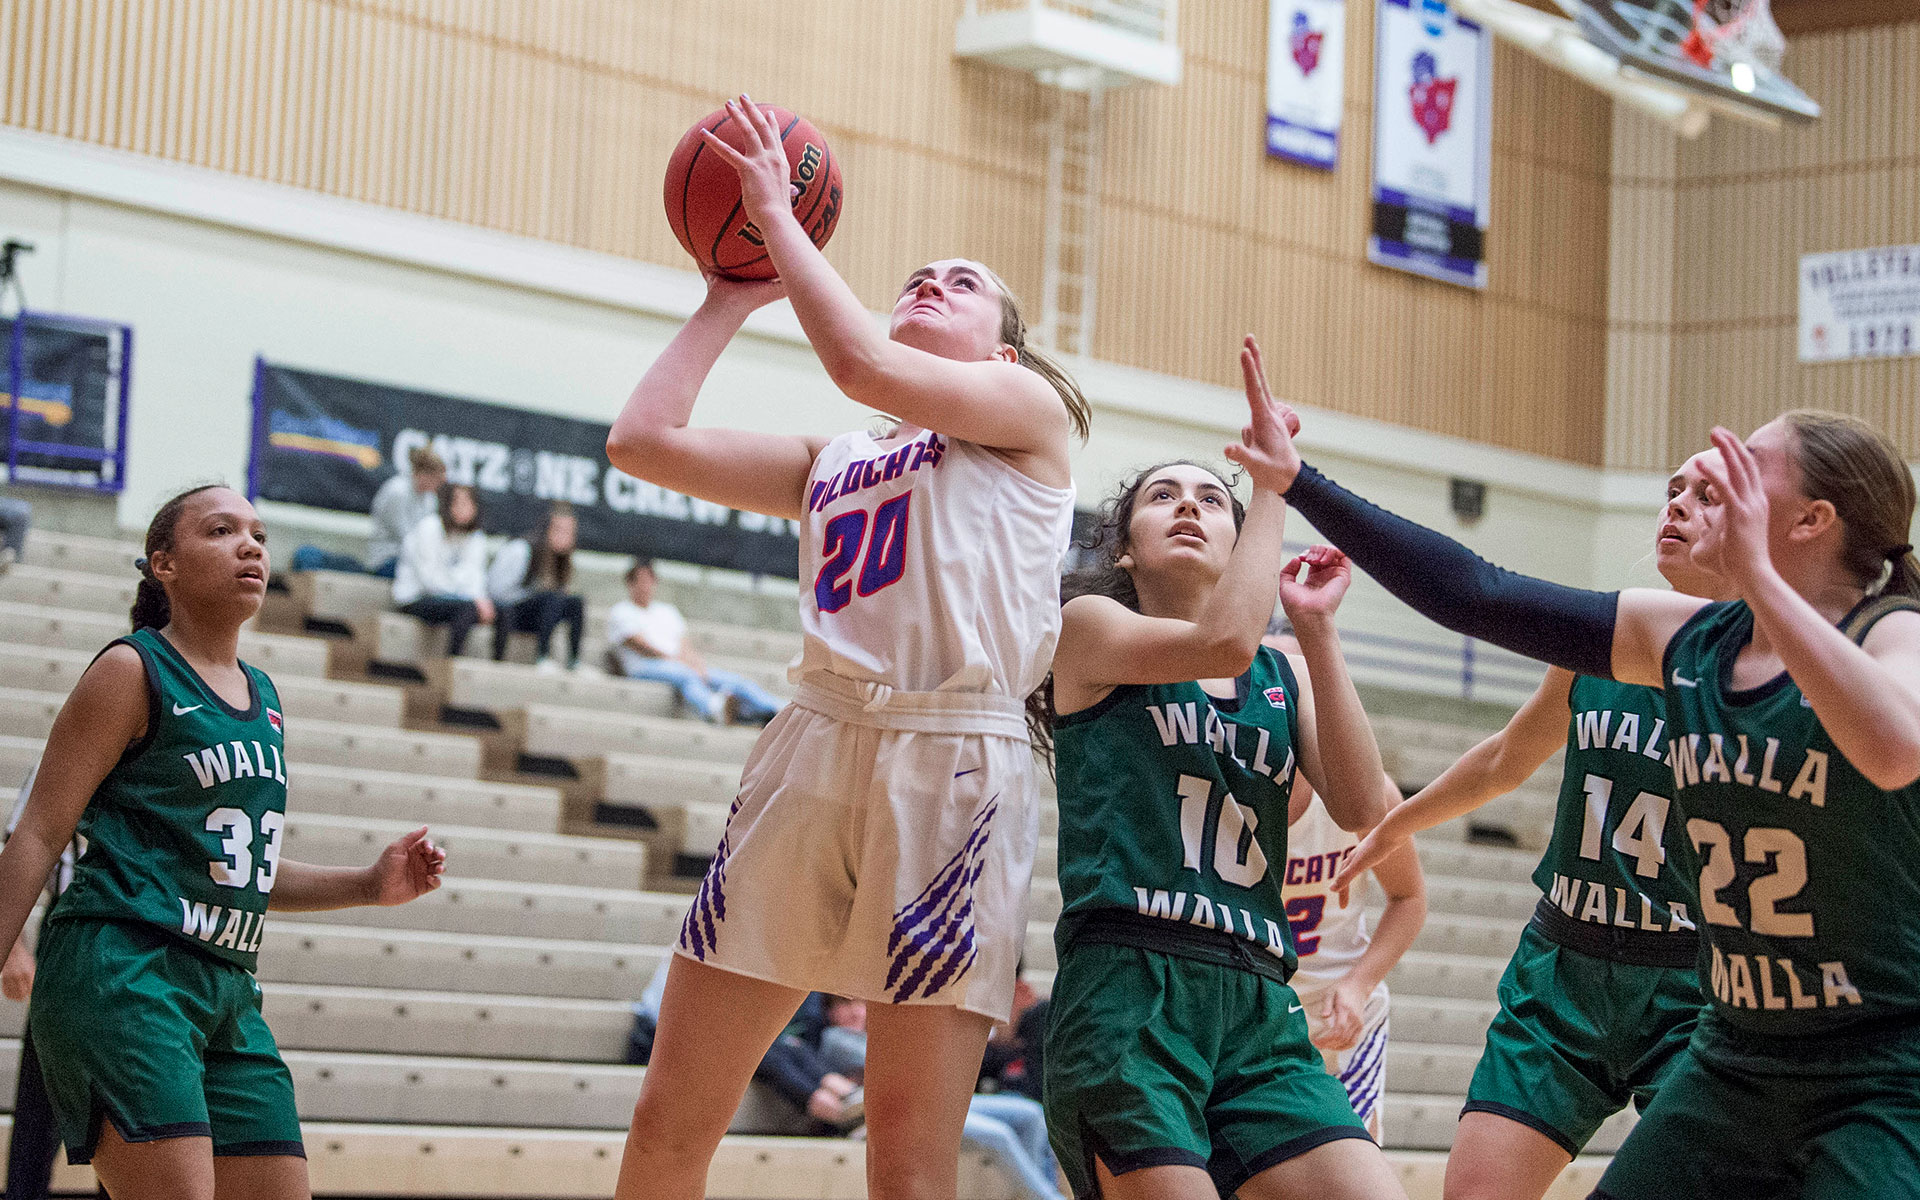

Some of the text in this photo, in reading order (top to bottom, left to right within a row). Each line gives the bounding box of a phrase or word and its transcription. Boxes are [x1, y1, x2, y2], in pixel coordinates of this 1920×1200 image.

[814, 489, 912, 614] 20
[183, 740, 288, 790] WALL
[1146, 702, 1296, 795] WALLA
[1668, 734, 1829, 808] WALLA
[206, 807, 284, 893] 33
[1177, 774, 1268, 888] 10
[1579, 774, 1671, 879] 14
[1550, 872, 1696, 932] WALLA
[1686, 818, 1814, 938] 22
[179, 896, 265, 953] WALL
[1711, 942, 1863, 1010] WALLA
